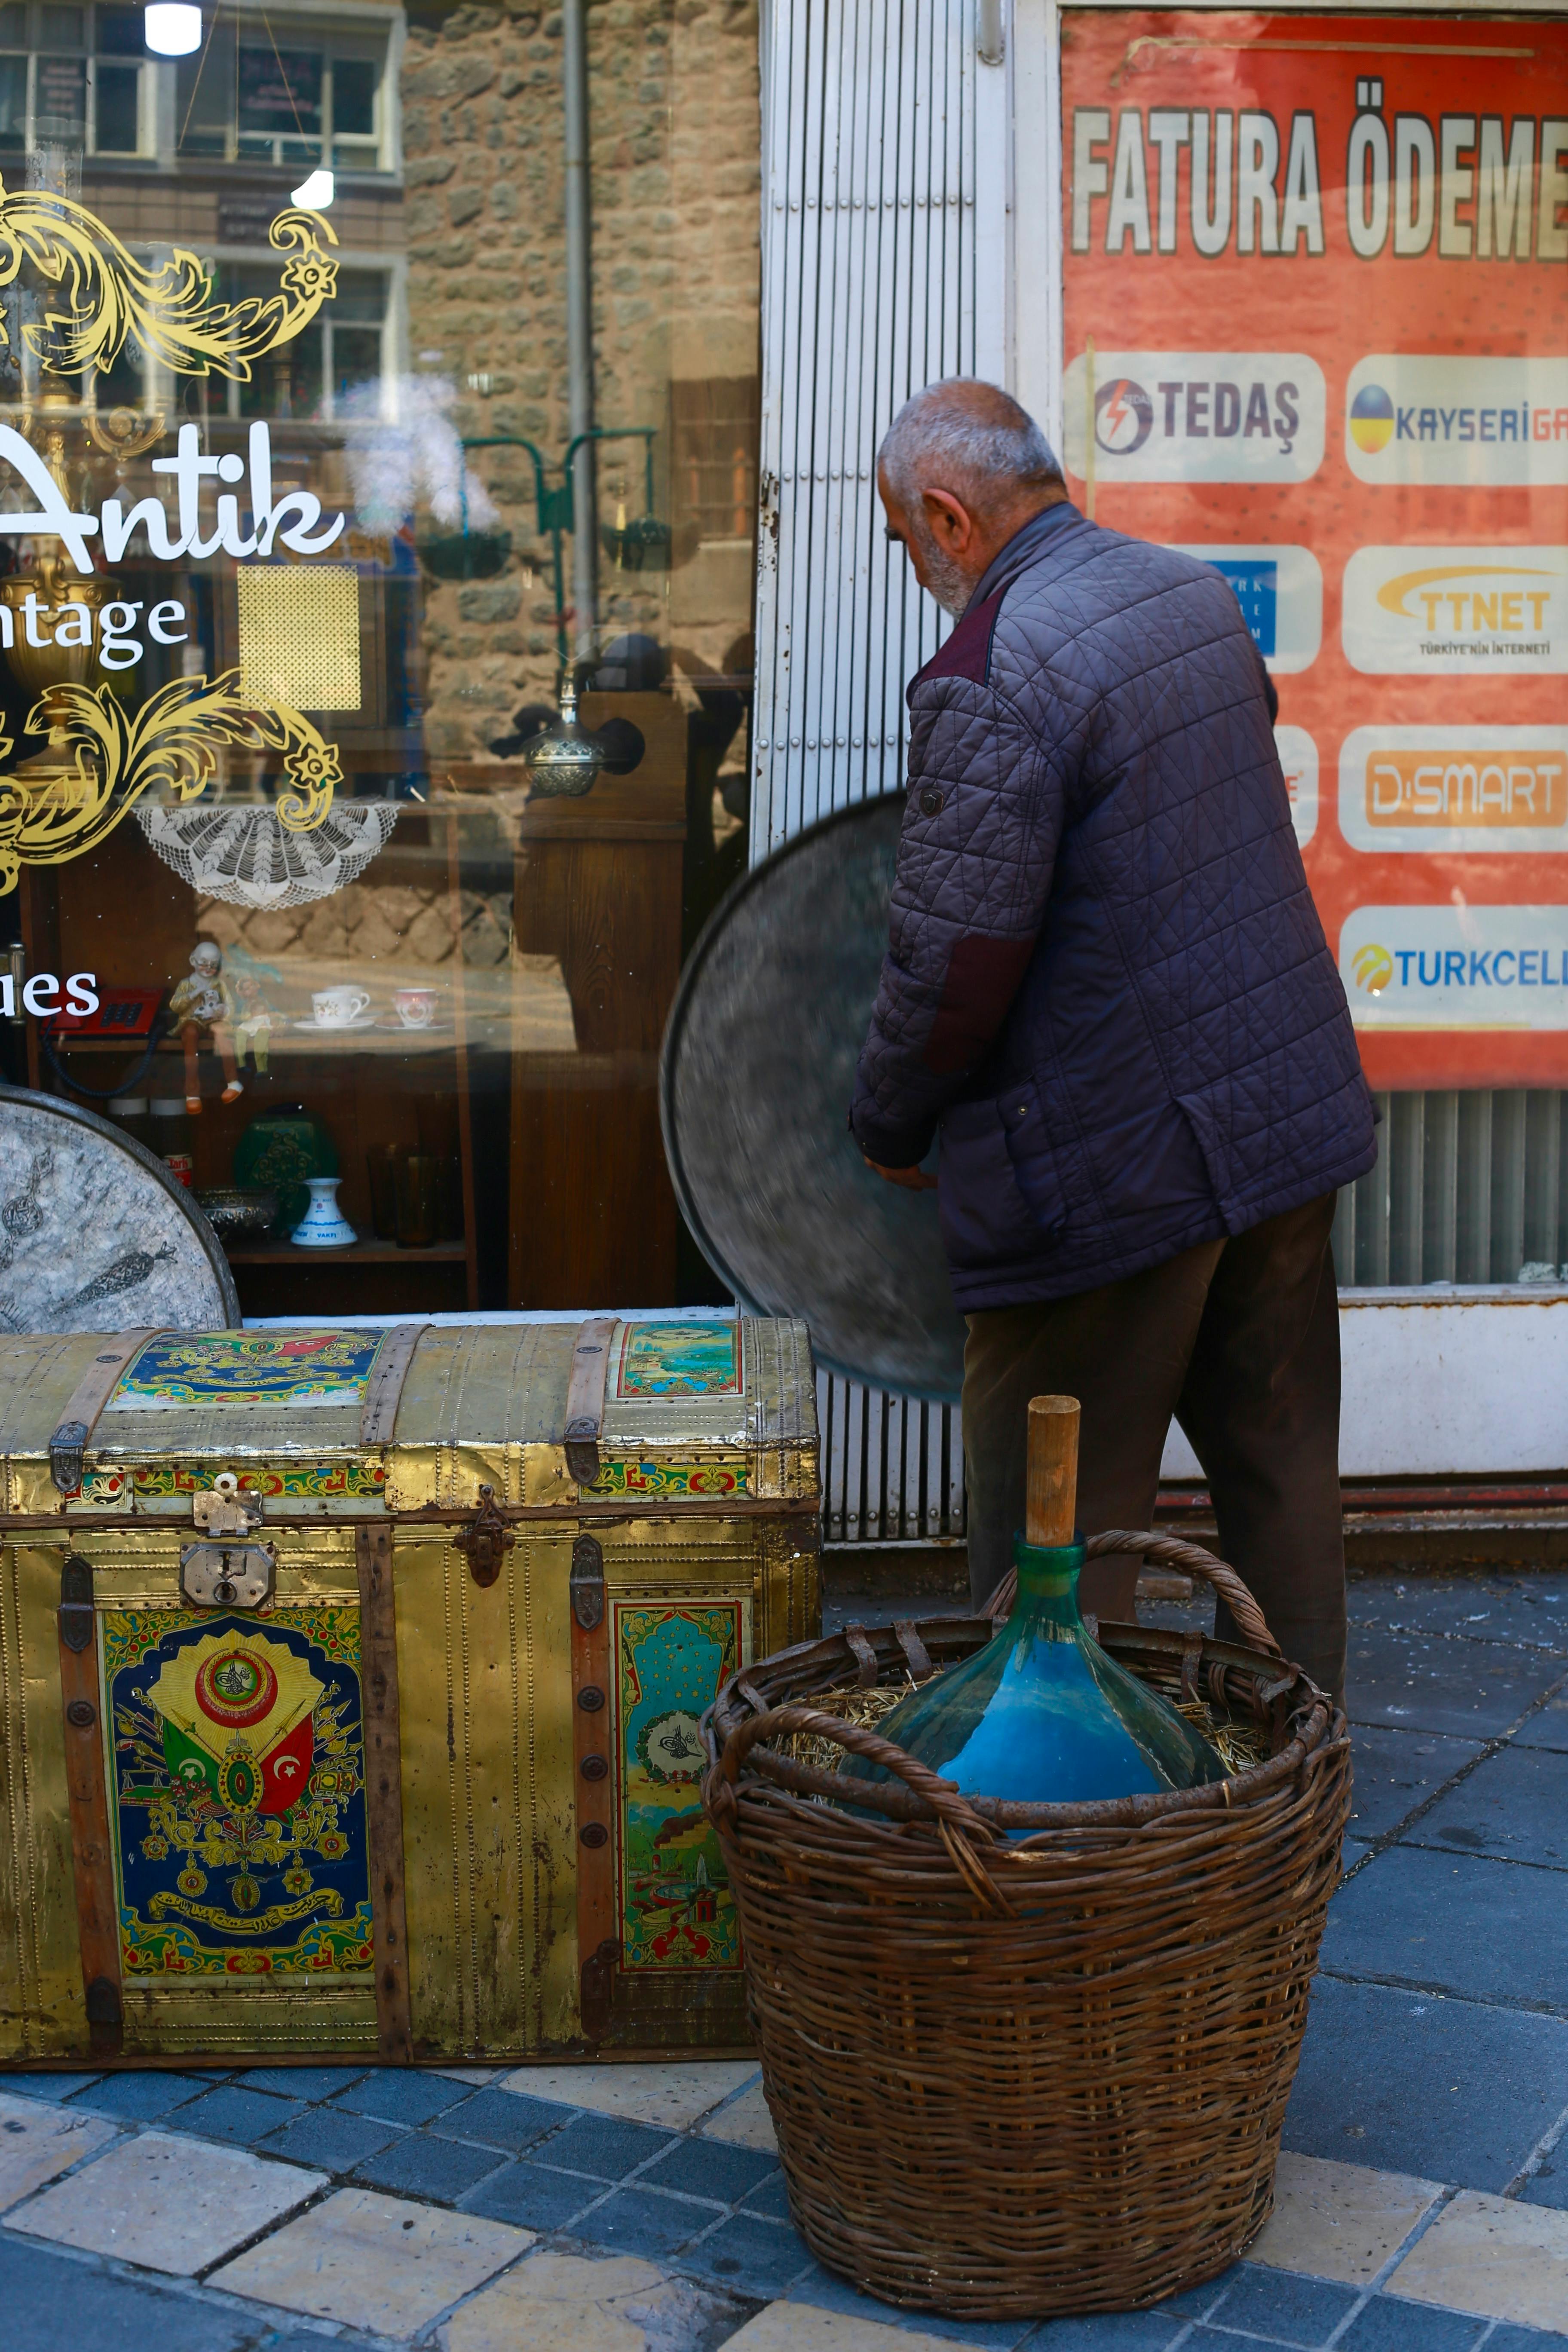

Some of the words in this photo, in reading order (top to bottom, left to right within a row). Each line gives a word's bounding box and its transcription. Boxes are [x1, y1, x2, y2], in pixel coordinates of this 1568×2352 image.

[1070, 106, 1326, 259] FATURA
[1346, 75, 1568, 263] ÖDEME
[1158, 382, 1299, 454] TEDAŞ
[1420, 591, 1550, 631] TTNET
